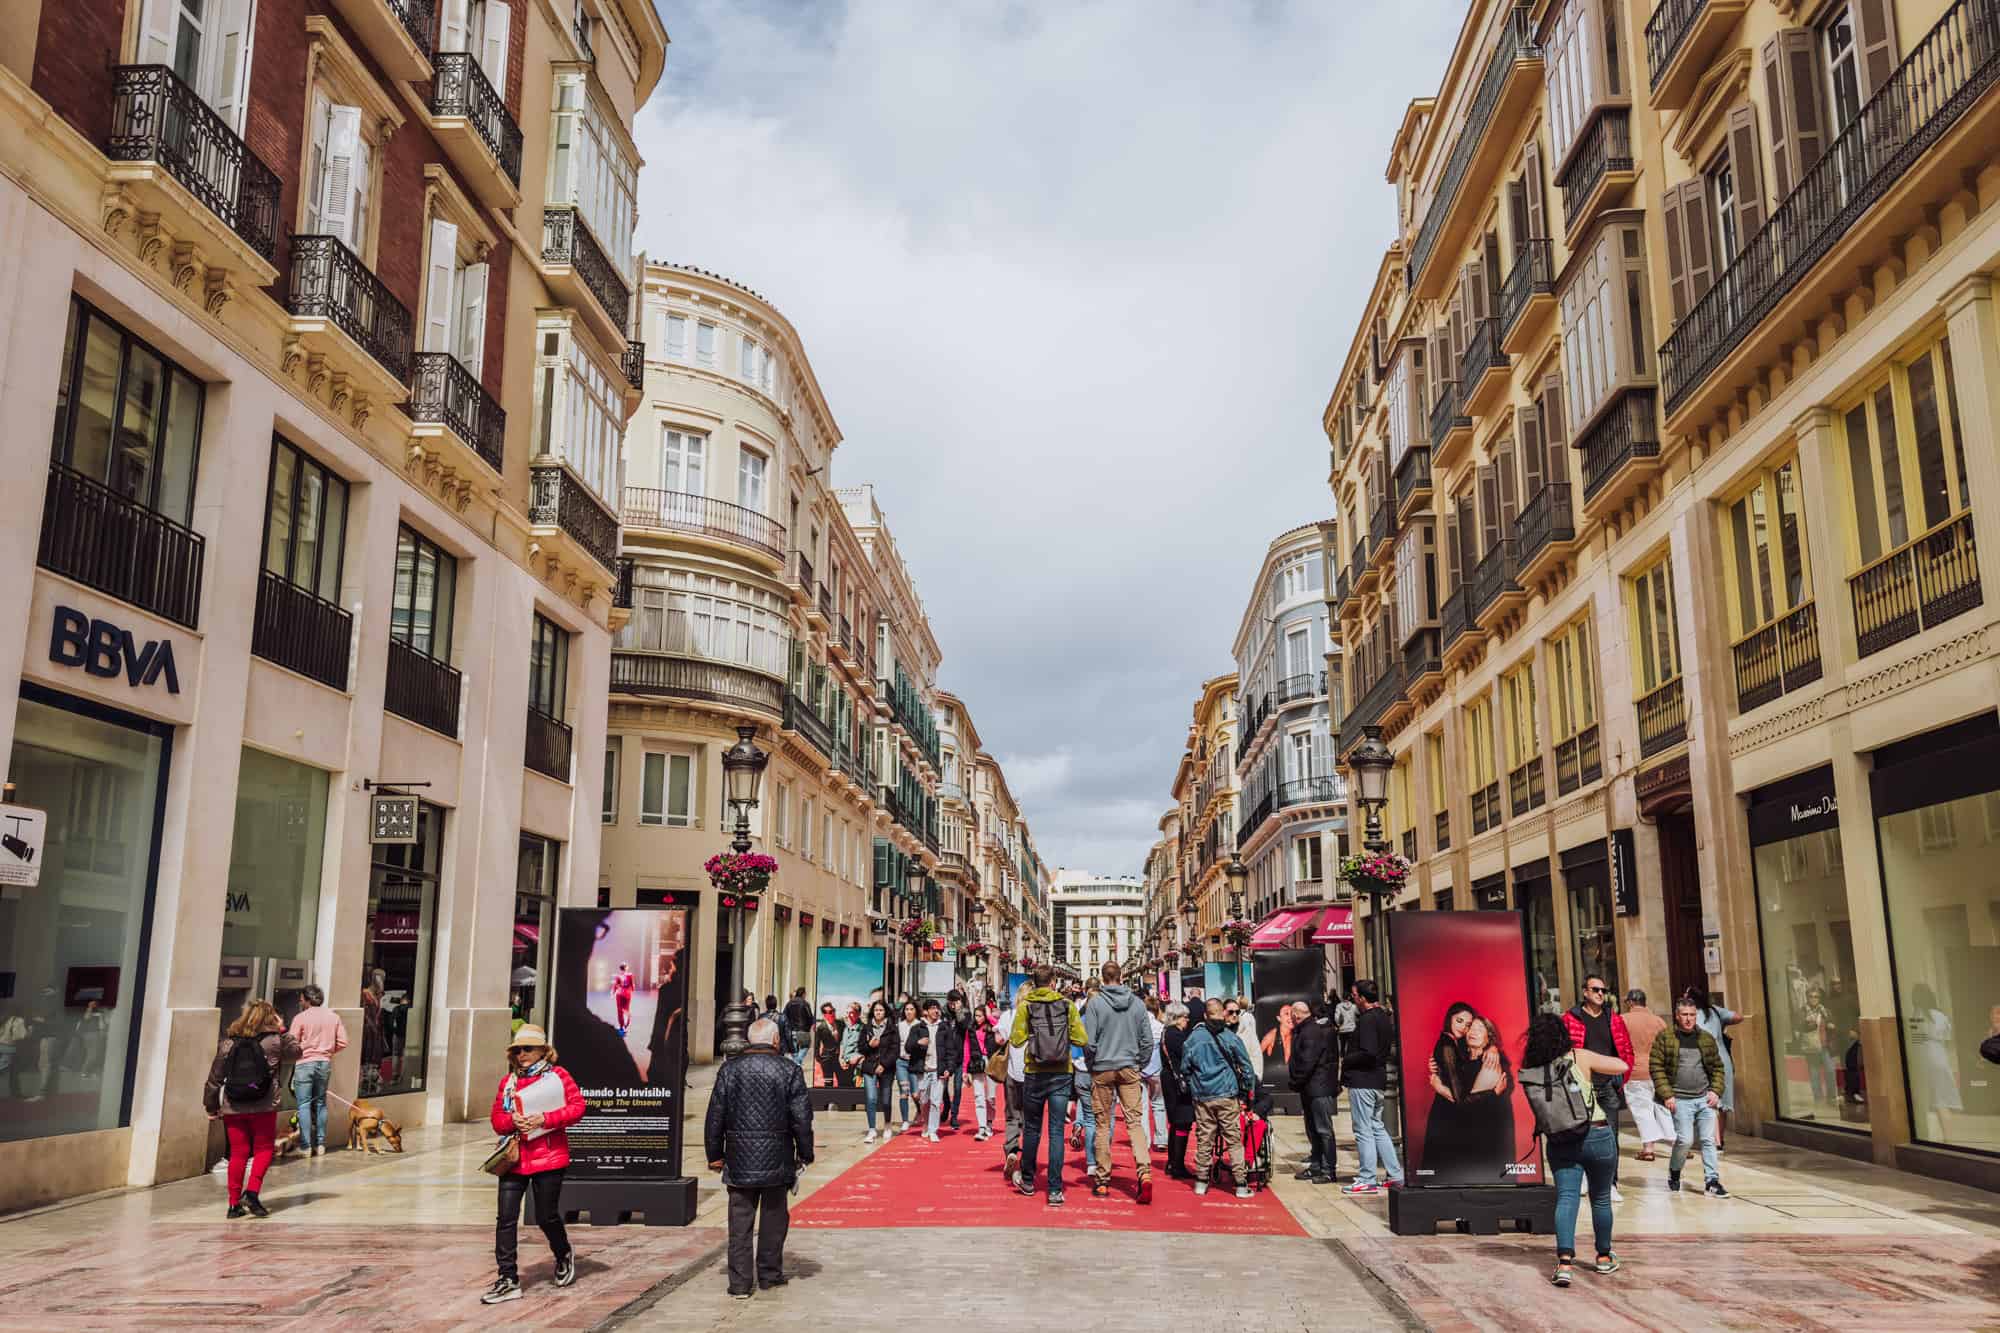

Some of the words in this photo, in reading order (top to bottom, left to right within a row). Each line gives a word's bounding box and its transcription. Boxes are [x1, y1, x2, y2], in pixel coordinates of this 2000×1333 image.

[49, 605, 180, 694] BBVA
[1791, 804, 1822, 822] Massimo
[616, 1088, 628, 1097] Lo
[629, 1088, 671, 1097] Invisible
